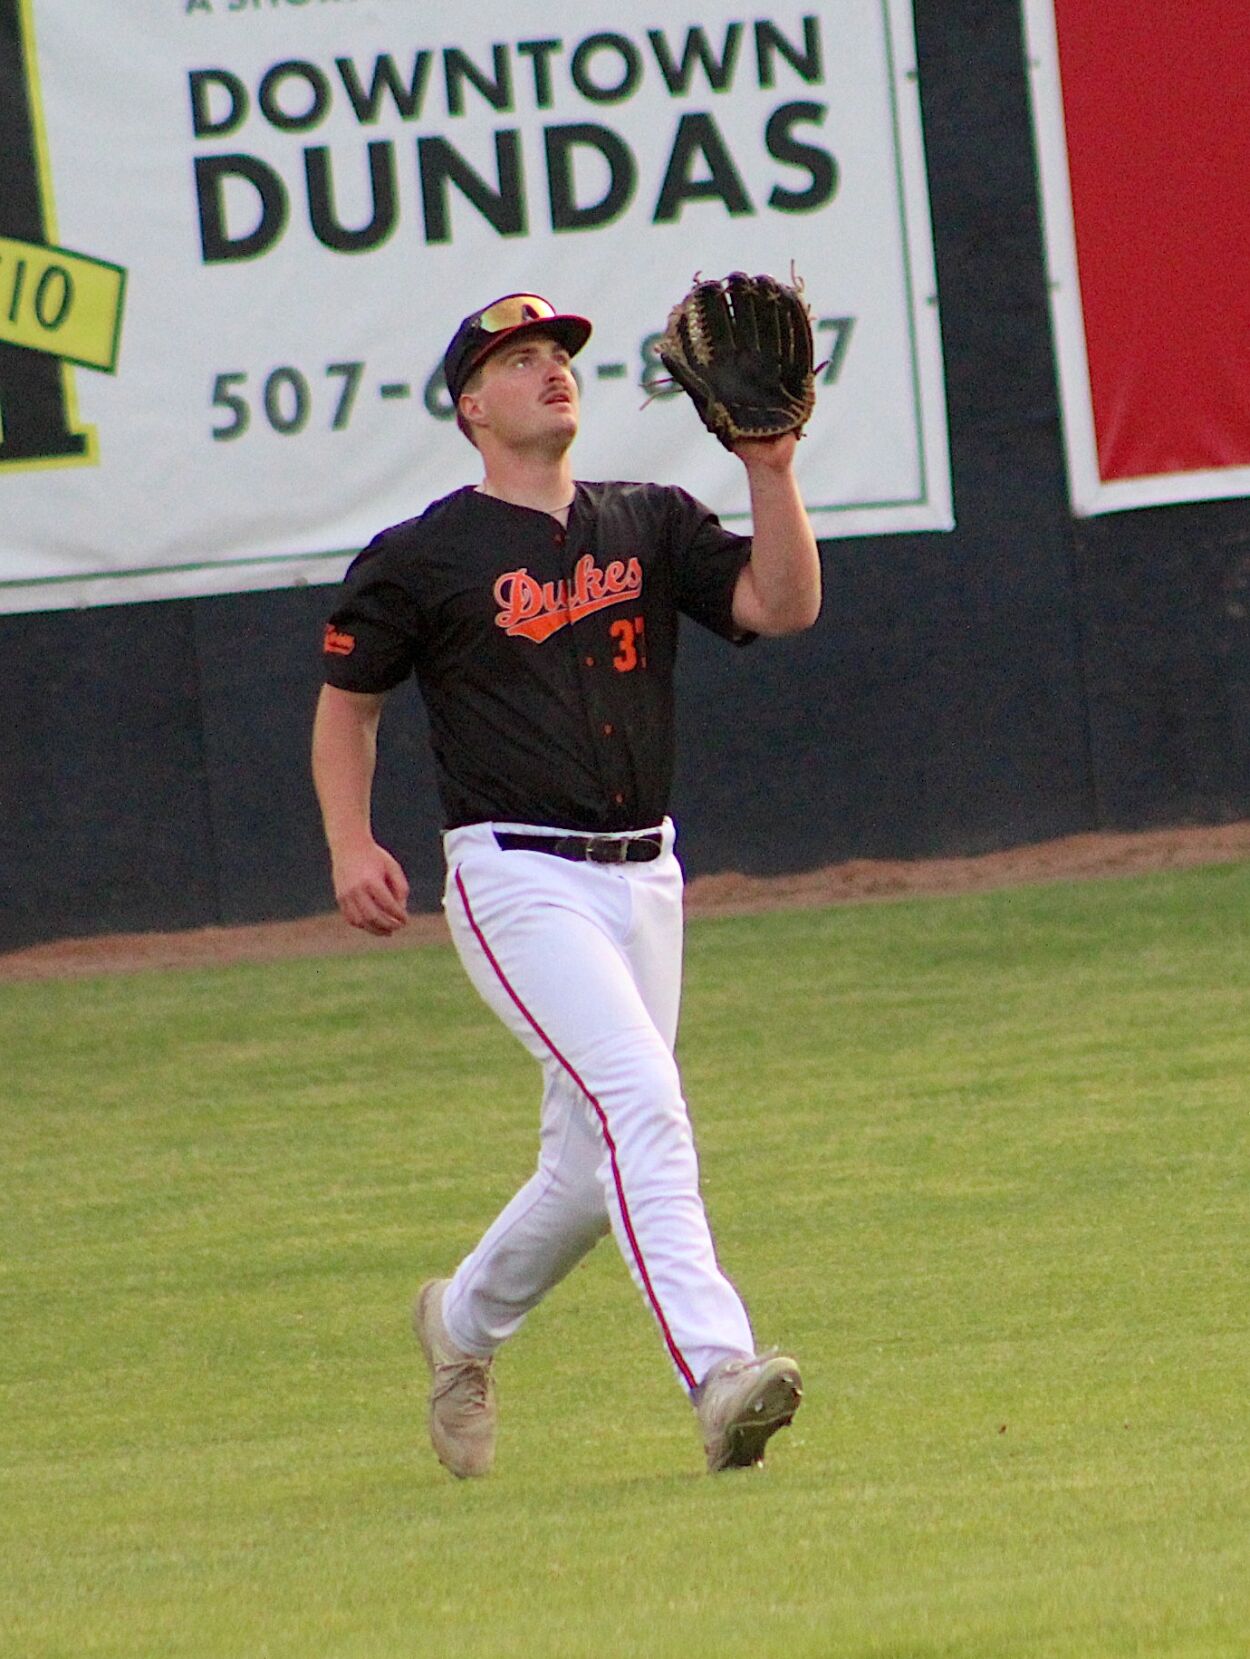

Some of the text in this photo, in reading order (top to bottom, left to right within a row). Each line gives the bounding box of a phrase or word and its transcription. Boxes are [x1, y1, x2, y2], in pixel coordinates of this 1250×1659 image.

[189, 15, 823, 139] DOWNTOWN
[194, 101, 839, 265] DUNDAS
[212, 316, 857, 443] 507-6-87
[493, 553, 643, 628] Dukes
